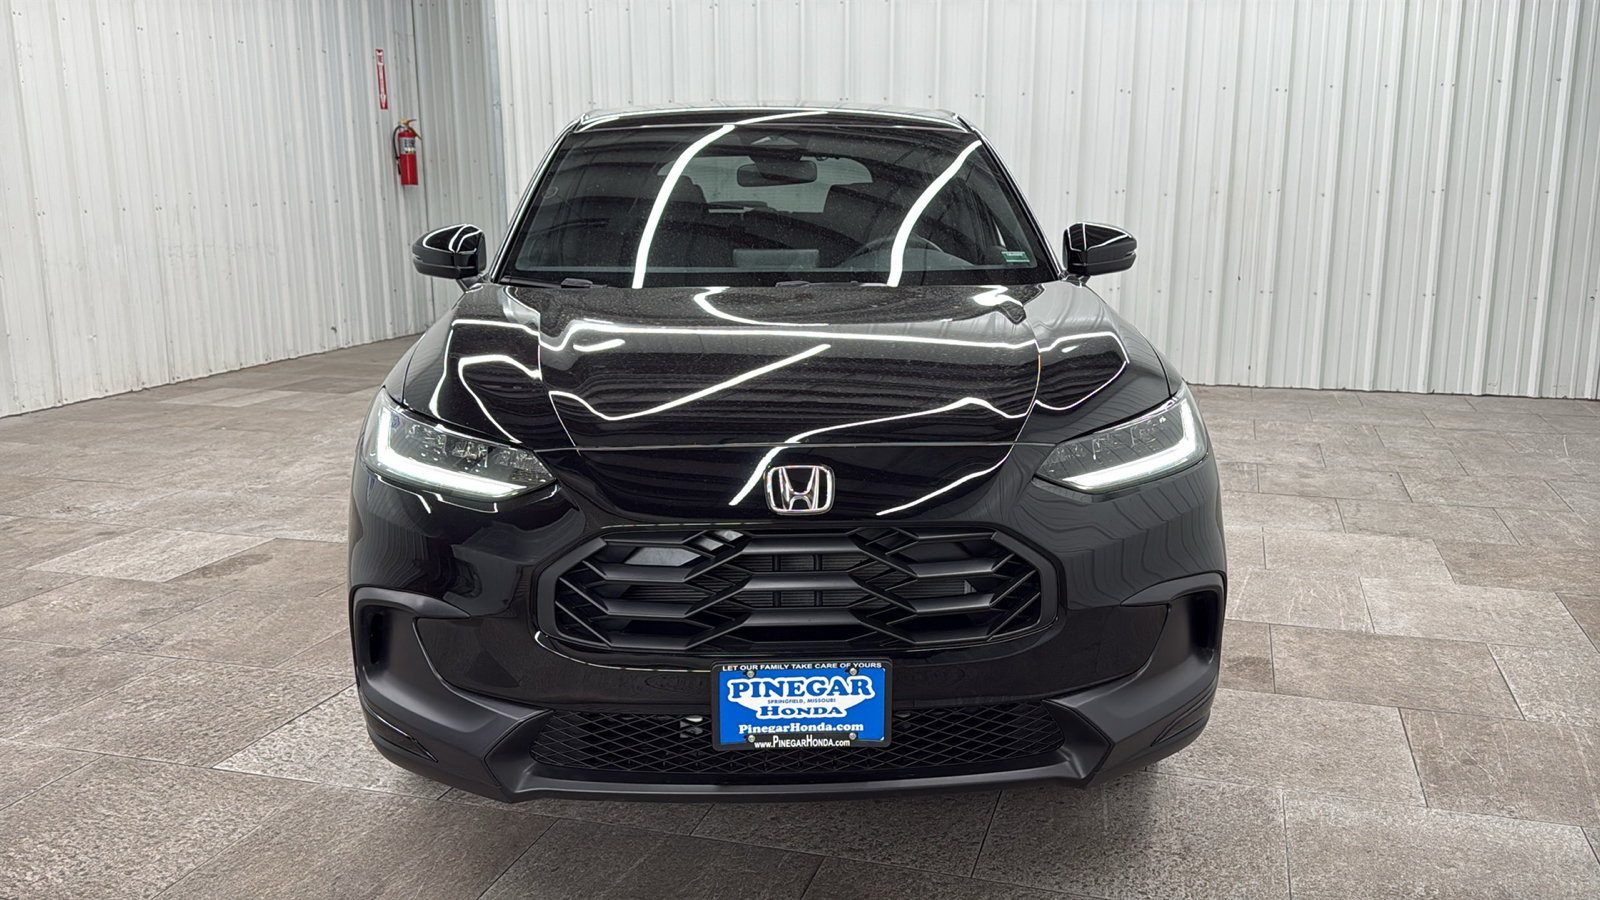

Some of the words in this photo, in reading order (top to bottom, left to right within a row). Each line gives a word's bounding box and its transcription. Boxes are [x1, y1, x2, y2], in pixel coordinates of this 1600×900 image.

[730, 678, 872, 699] PINEGAR
[759, 705, 843, 717] HONDA
[738, 722, 864, 735] PinegarHonda.com
